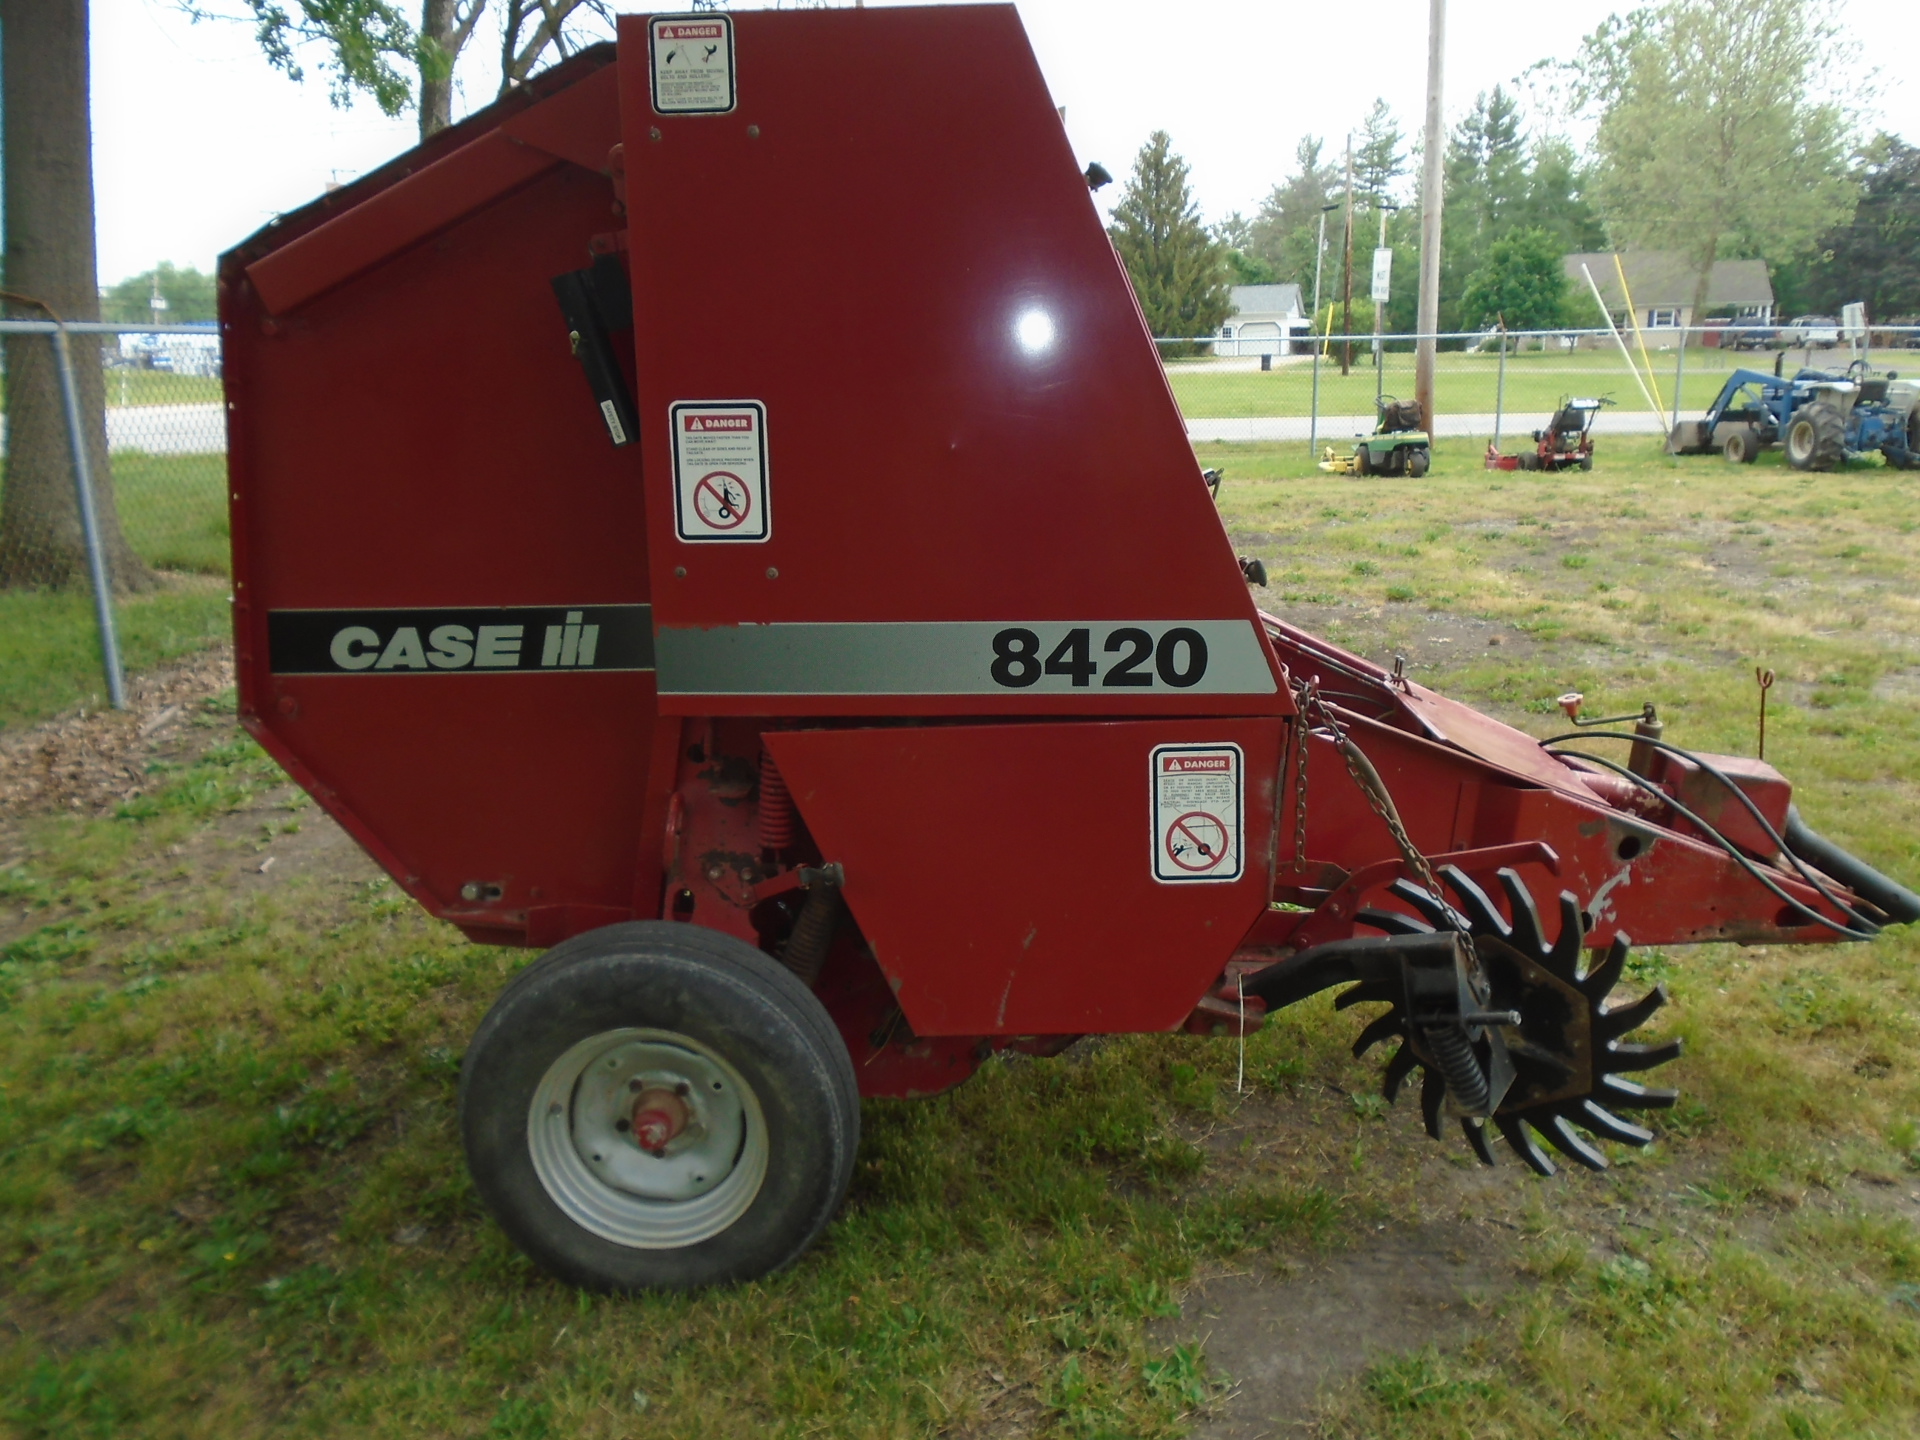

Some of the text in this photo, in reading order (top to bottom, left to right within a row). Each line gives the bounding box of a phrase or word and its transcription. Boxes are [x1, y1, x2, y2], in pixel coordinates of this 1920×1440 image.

[678, 26, 717, 36] DANGER
[705, 419, 748, 428] DANGER
[329, 624, 524, 670] CASE
[990, 627, 1208, 688] 8420
[1184, 760, 1226, 768] DANGER
